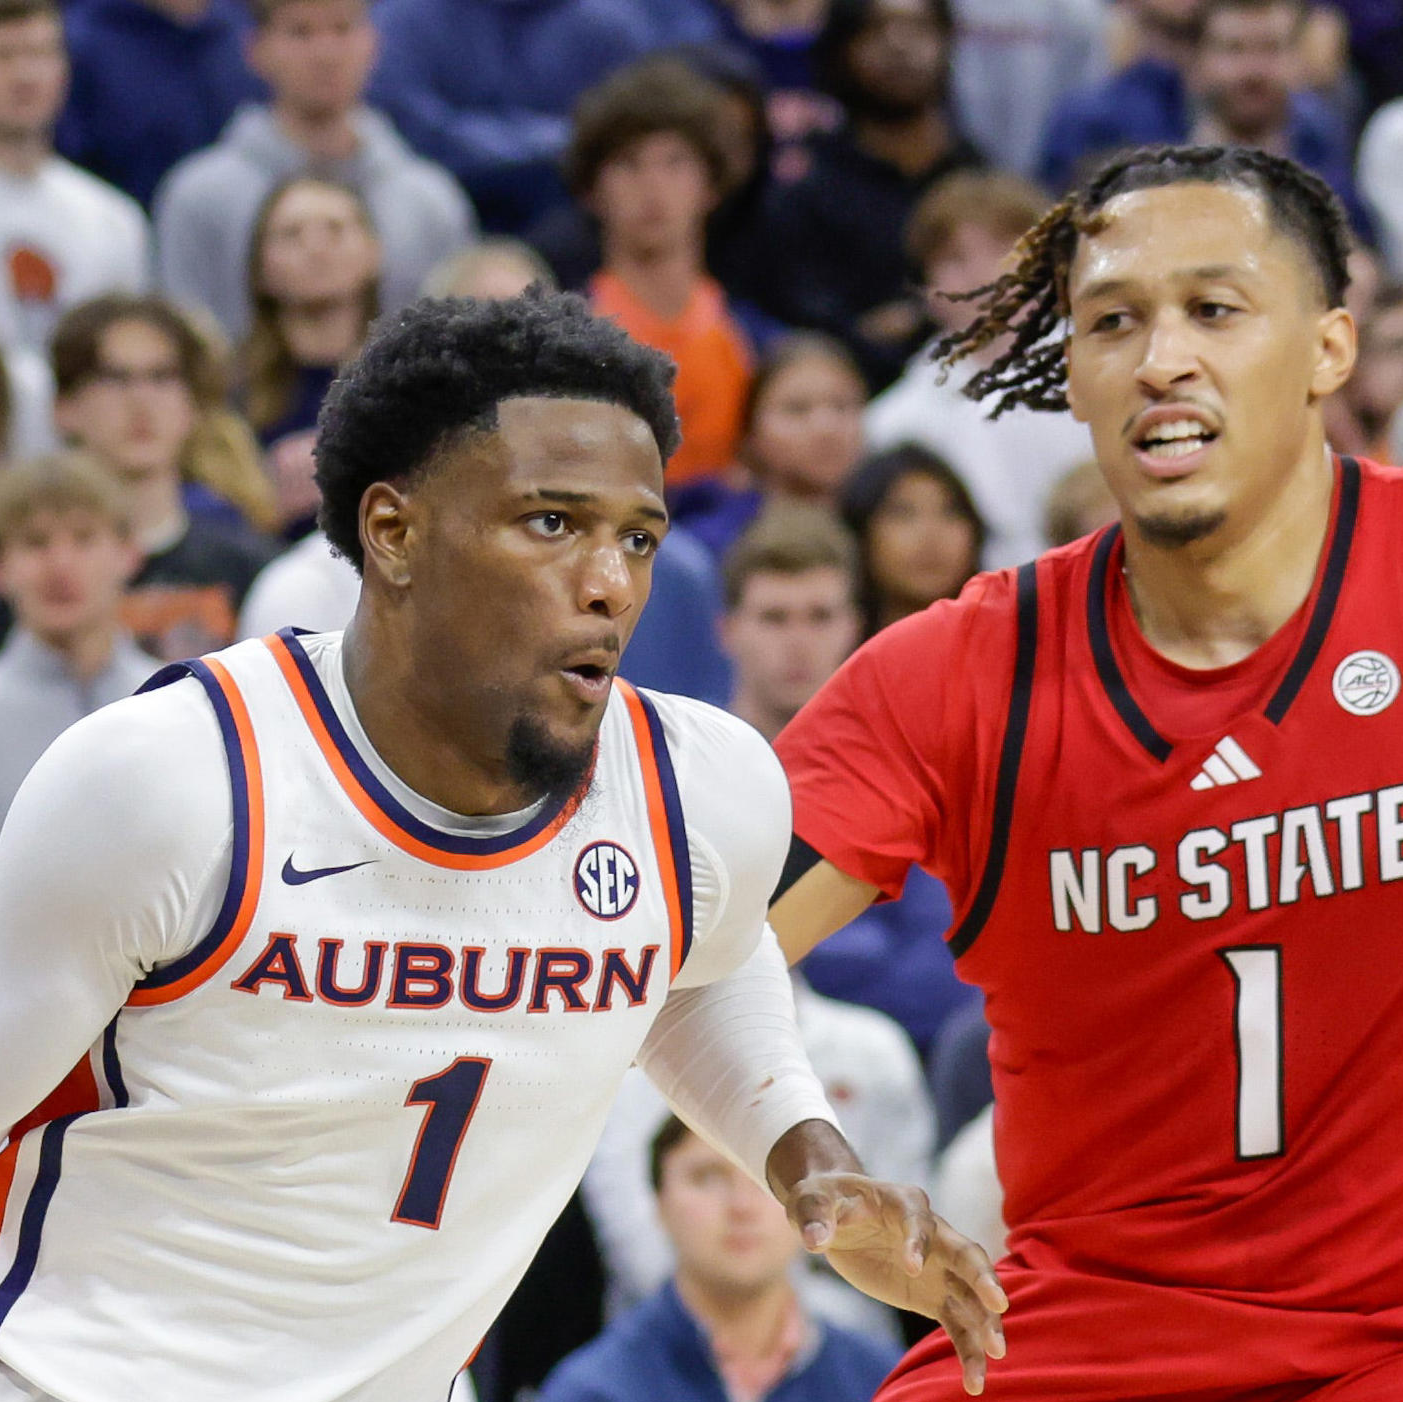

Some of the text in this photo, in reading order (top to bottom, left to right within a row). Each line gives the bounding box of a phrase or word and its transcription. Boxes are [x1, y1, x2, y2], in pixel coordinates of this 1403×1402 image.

[1345, 671, 1389, 688] ACC
[578, 846, 636, 915] SEC
[1048, 842, 1160, 935] NC
[230, 932, 660, 1014] AUBURN
[1214, 943, 1287, 1163] 1
[390, 1055, 494, 1231] 1
